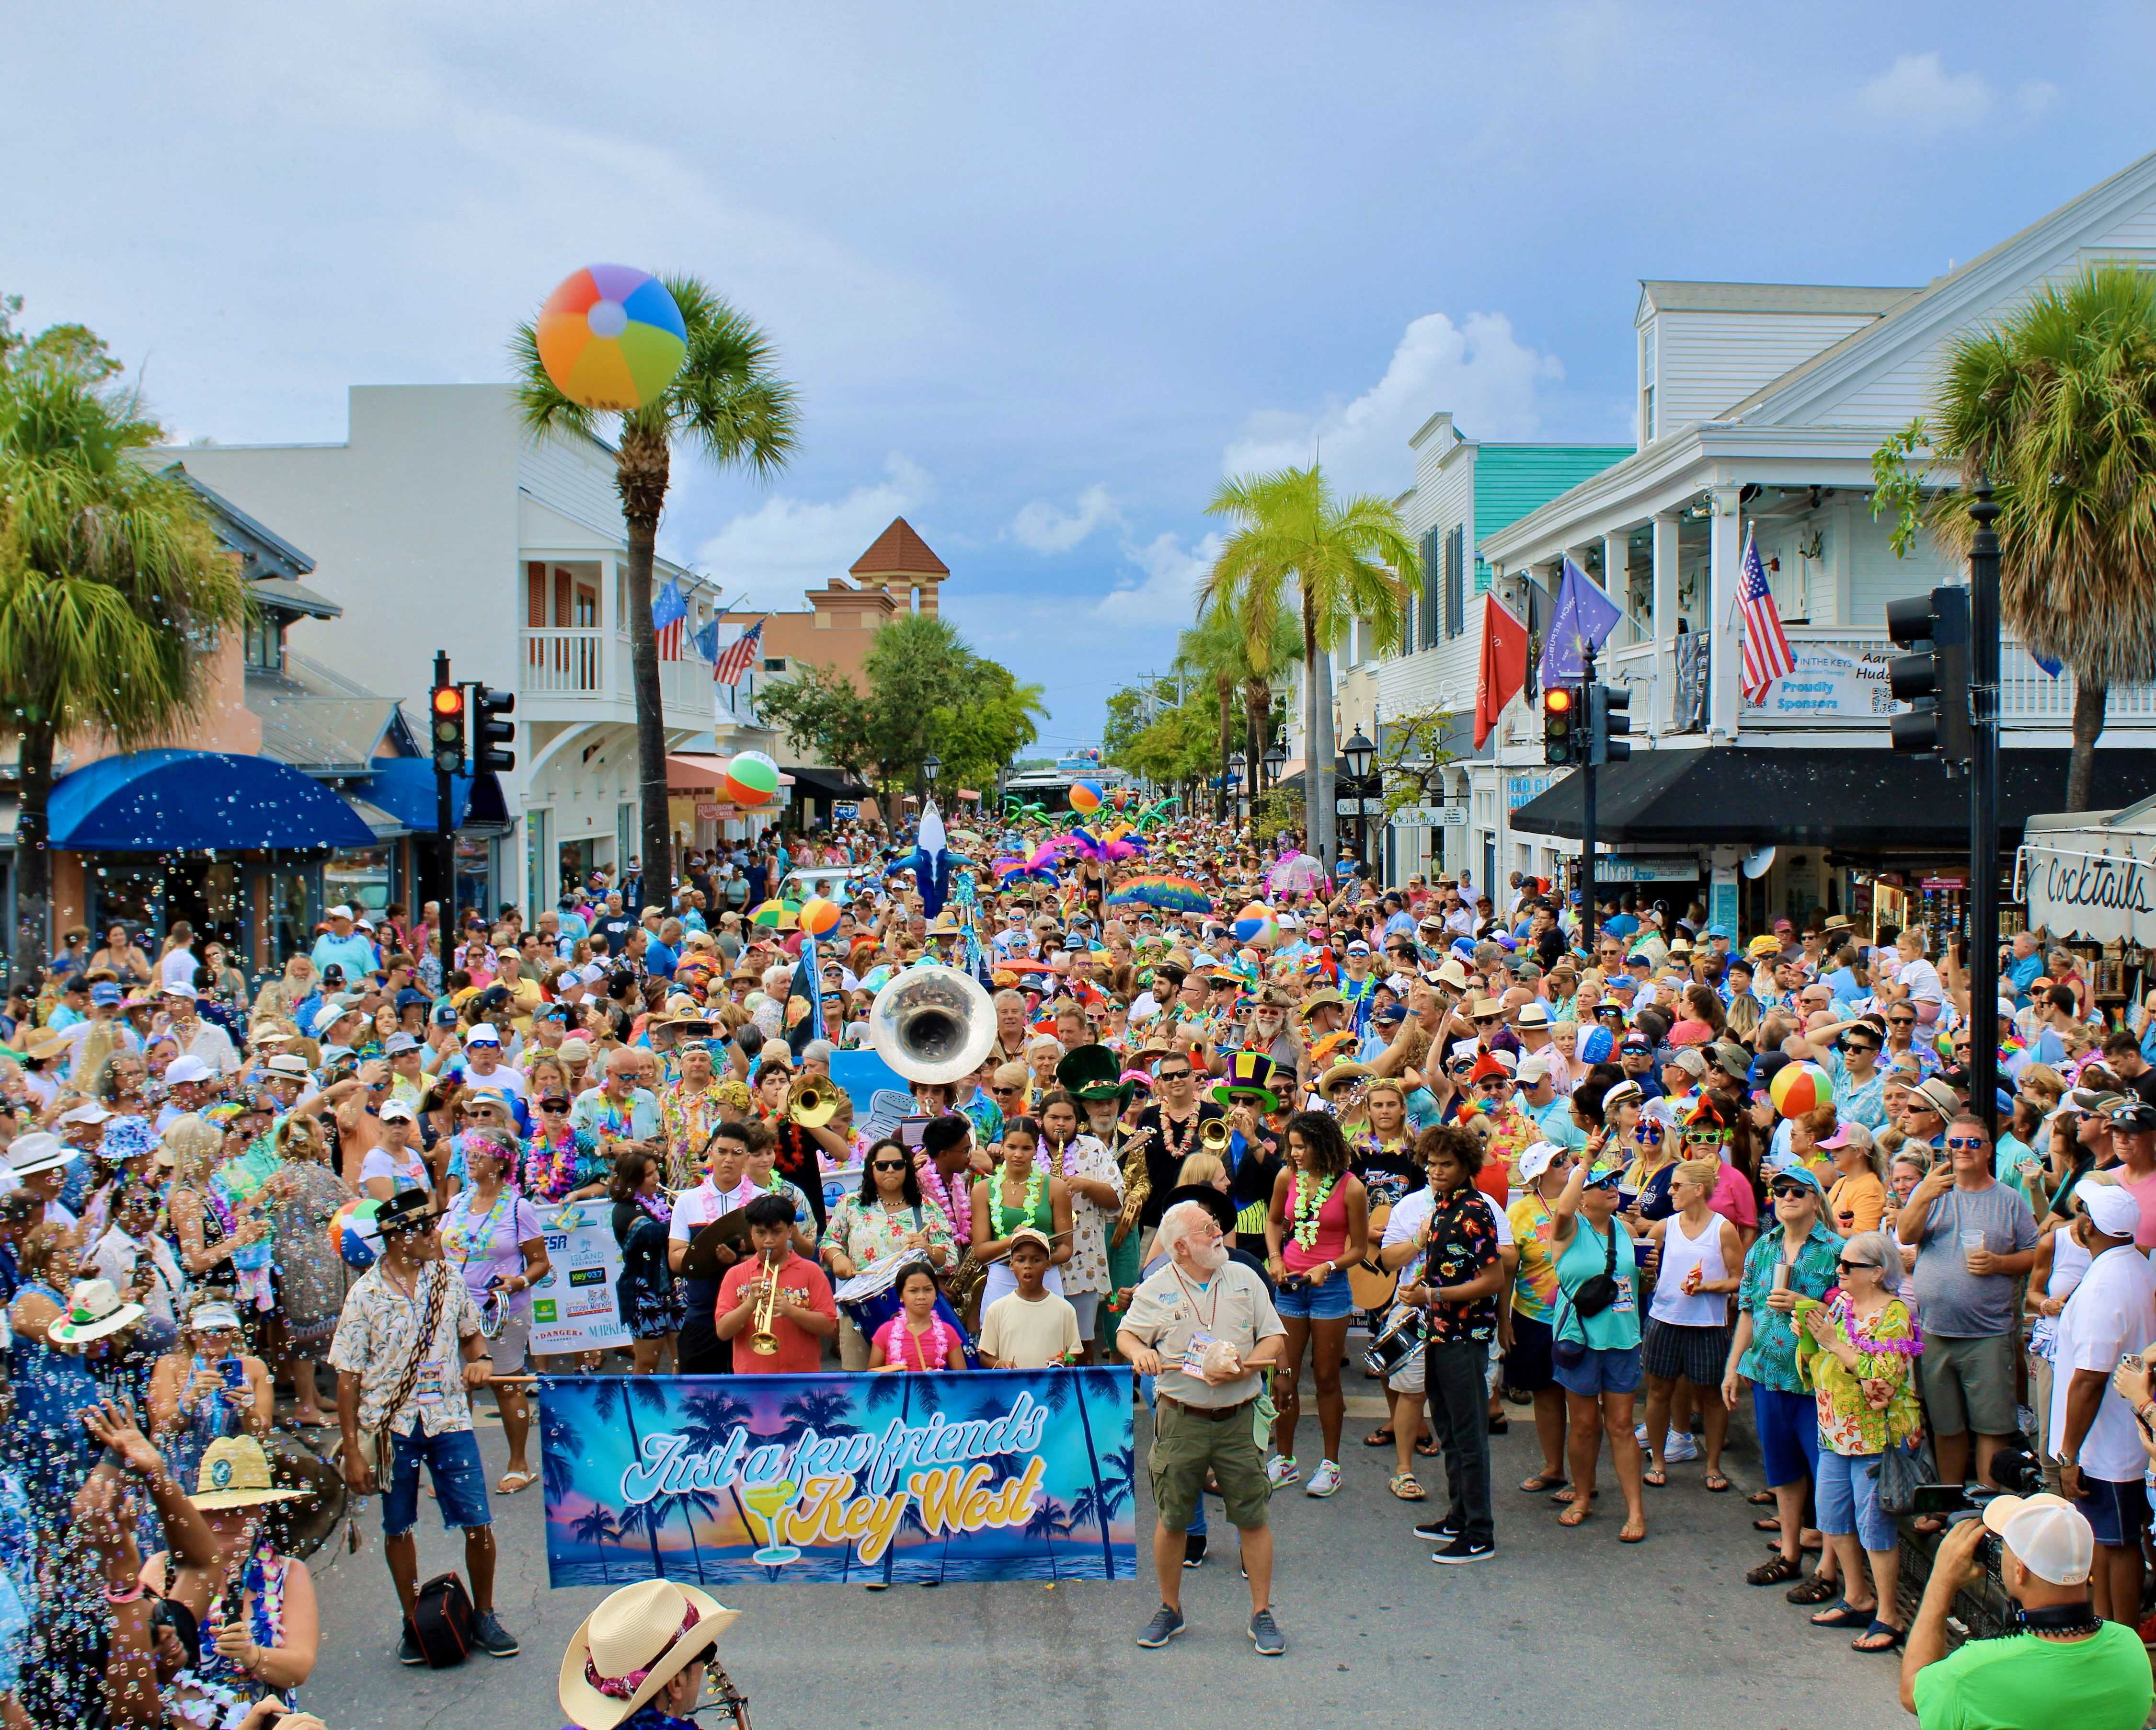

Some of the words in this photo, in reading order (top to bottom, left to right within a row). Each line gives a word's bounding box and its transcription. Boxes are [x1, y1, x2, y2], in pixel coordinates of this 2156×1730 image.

[1812, 658, 1829, 666] THE
[1831, 658, 1852, 668] KEYS
[1862, 653, 1896, 664] Aar
[1781, 682, 1834, 695] Proudly
[1777, 699, 1838, 711] Sponsors
[698, 804, 734, 816] RAINBOW
[2047, 855, 2154, 913] Cocktails
[1583, 1043, 1601, 1060] Keep
[1593, 1029, 1605, 1041] The
[1359, 1168, 1386, 1180] Jimmy
[1366, 1173, 1399, 1187] Buffett
[571, 1251, 604, 1262] ISLAND
[572, 1272, 587, 1281] Key
[587, 1270, 603, 1279] 93.7
[540, 1329, 578, 1339] DANGER
[621, 1426, 748, 1505] Just
[739, 1444, 785, 1487] a
[781, 1428, 876, 1496] few
[867, 1391, 1048, 1495] friends
[785, 1473, 910, 1566] Key
[907, 1455, 1047, 1536] West
